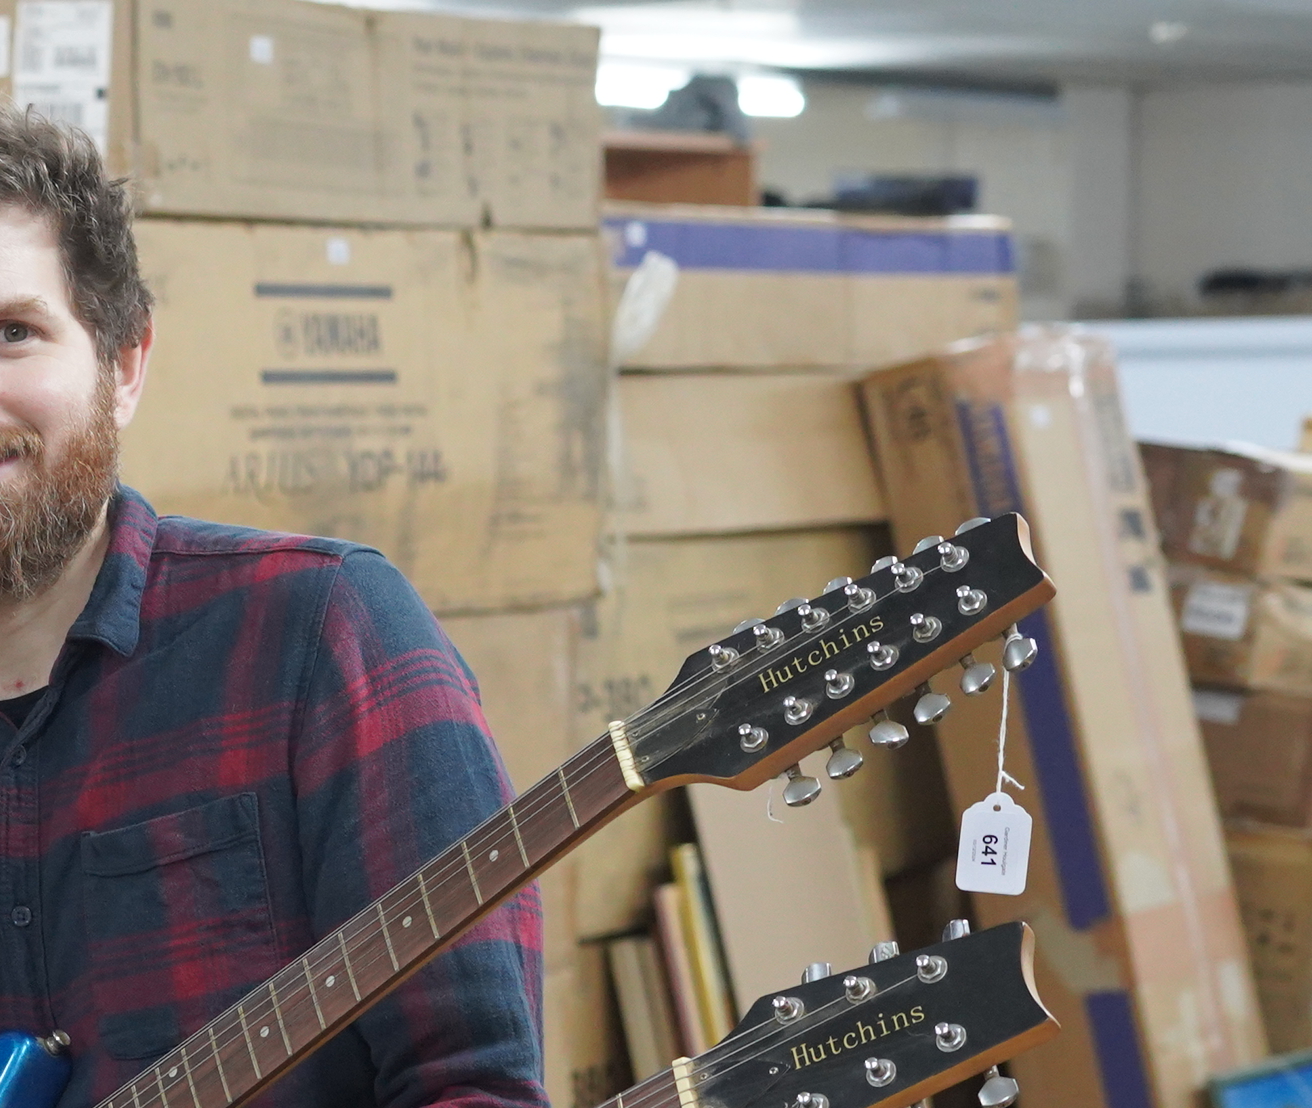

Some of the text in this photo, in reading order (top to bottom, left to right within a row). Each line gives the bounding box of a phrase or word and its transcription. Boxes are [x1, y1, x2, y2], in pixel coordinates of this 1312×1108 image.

[758, 614, 884, 693] Hutchins
[980, 834, 999, 866] 641
[790, 1004, 926, 1070] Hutchins
